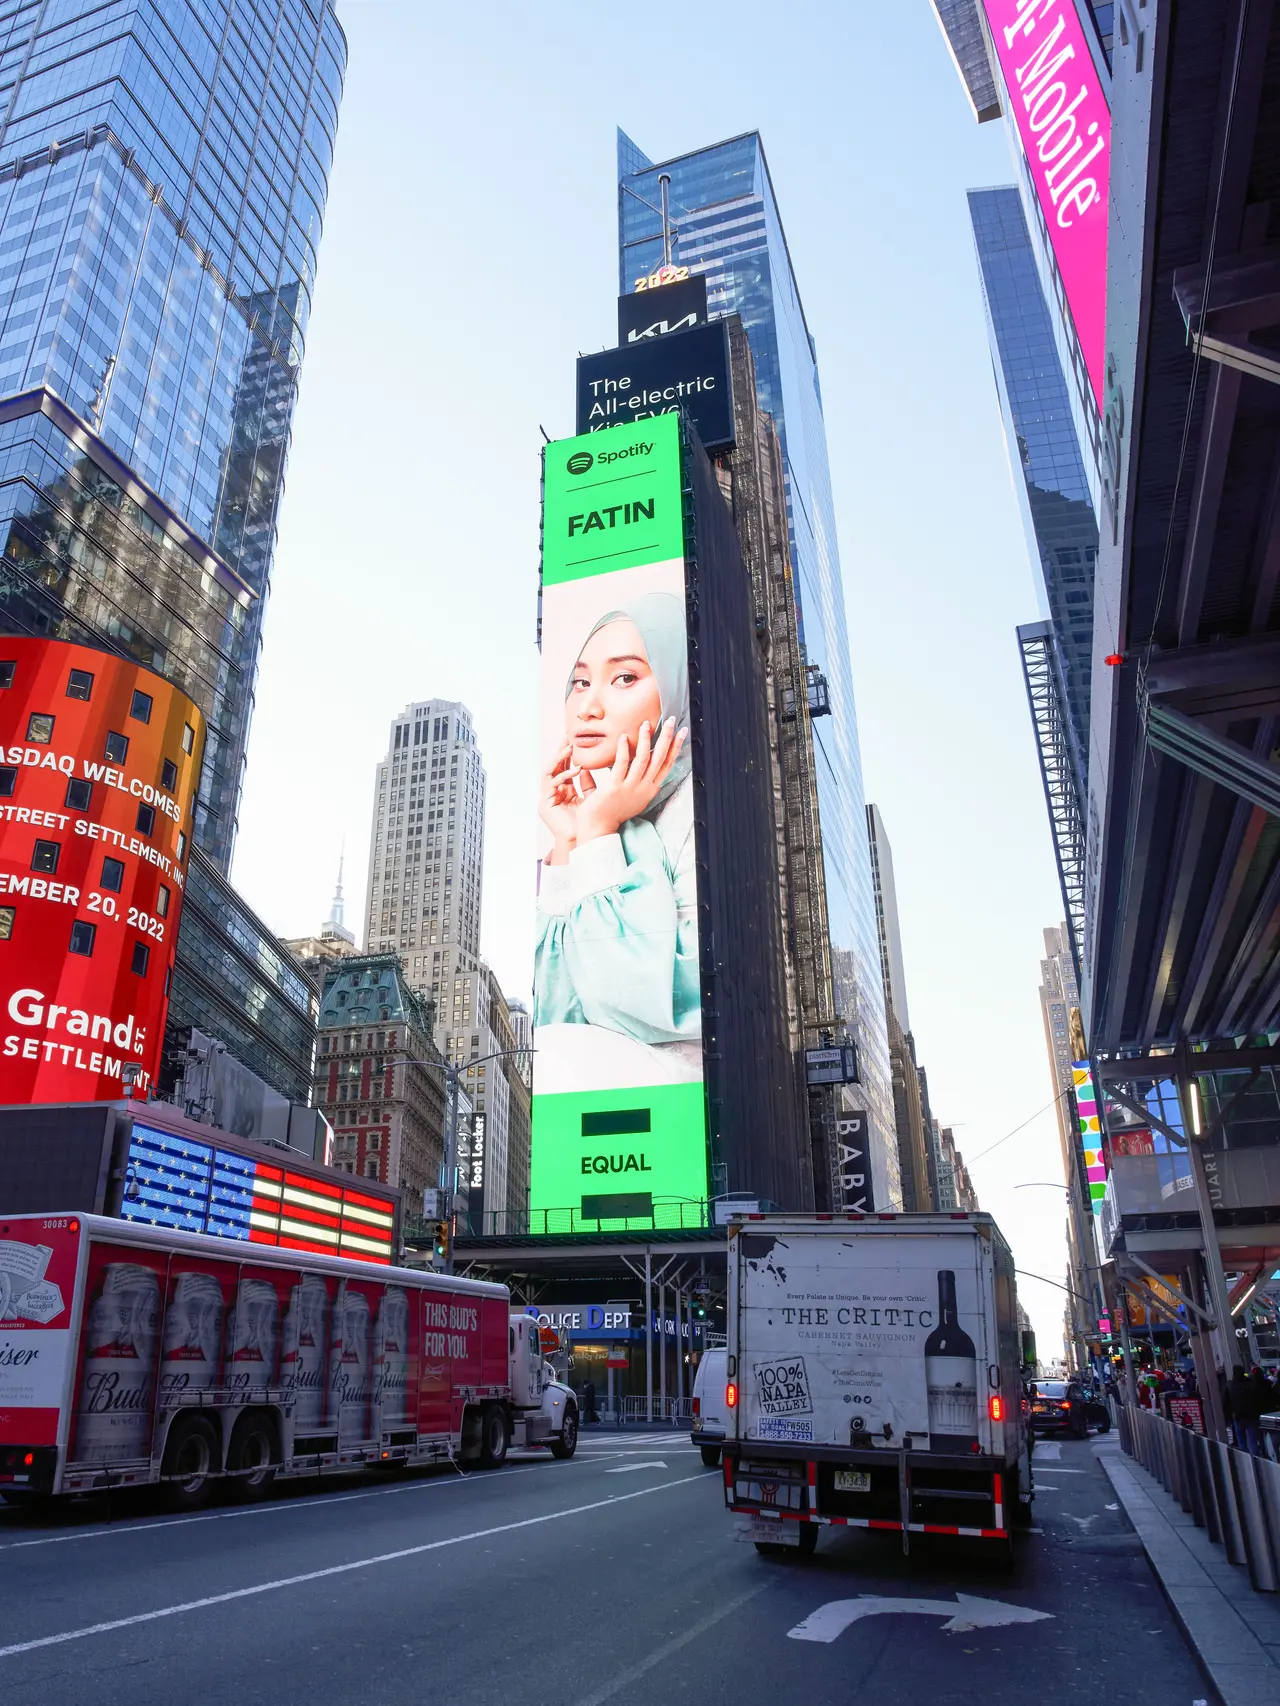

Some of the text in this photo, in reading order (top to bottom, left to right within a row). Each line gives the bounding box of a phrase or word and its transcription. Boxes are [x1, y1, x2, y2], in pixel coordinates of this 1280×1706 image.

[634, 266, 689, 293] 2022
[589, 376, 631, 397] The
[589, 376, 715, 420] All-electric
[597, 441, 655, 465] Spotify
[568, 497, 655, 538] FATIN
[83, 760, 181, 823] WELCOMES
[0, 805, 70, 830] TREET
[74, 819, 172, 877] SETTLEMENT,
[86, 891, 121, 922] 20,
[126, 906, 165, 942] 2022
[8, 988, 135, 1051] Grand
[3, 1035, 150, 1091] SETTLEMNT
[470, 1160, 484, 1188] Foot
[581, 1153, 652, 1175] EQUAL
[42, 1219, 68, 1229] 30083
[729, 1244, 736, 1253] 6
[983, 1246, 990, 1255] 6
[786, 1293, 805, 1301] Every
[836, 1294, 861, 1302] Unique.
[425, 1302, 477, 1332] THIS BUD'S
[587, 1305, 632, 1329] DEPT
[782, 1307, 933, 1328] THE CRITIC
[425, 1332, 469, 1359] FOR YOU.
[798, 1331, 916, 1342] CABERNET SAUVIGNON
[831, 1340, 881, 1349] Napa Valley
[757, 1364, 804, 1385] 100%
[760, 1382, 807, 1402] NAPA
[762, 1398, 808, 1414] VALLEY
